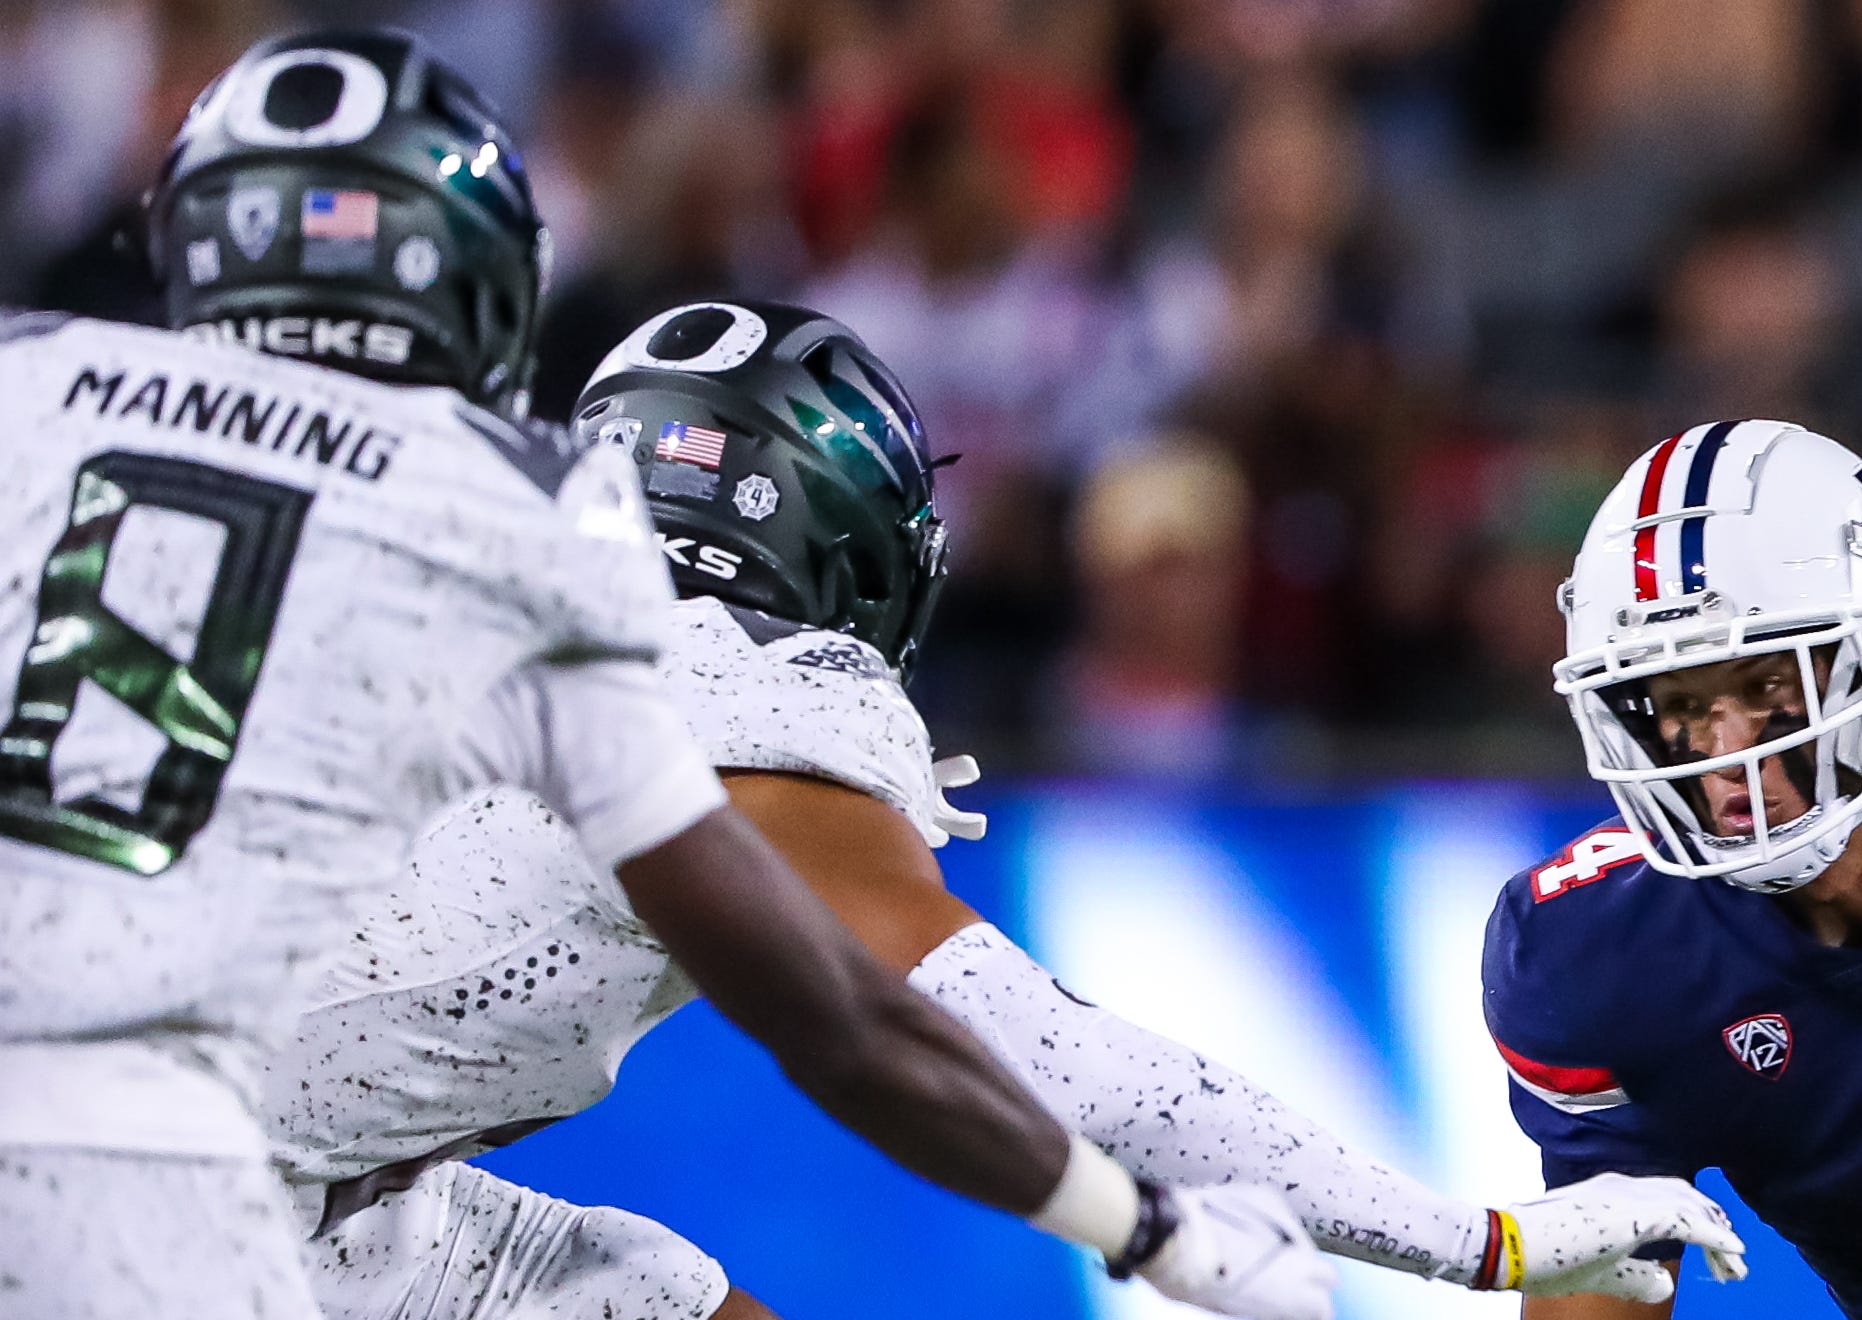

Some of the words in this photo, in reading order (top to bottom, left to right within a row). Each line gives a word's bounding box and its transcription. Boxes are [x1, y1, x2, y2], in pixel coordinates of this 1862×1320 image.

[185, 316, 413, 366] UCKS
[63, 364, 405, 483] MANNING
[751, 488, 763, 507] 4
[0, 447, 318, 877] 8
[1531, 826, 1652, 904] 4
[1727, 1018, 1790, 1063] PAC
[1750, 1042, 1785, 1072] 12
